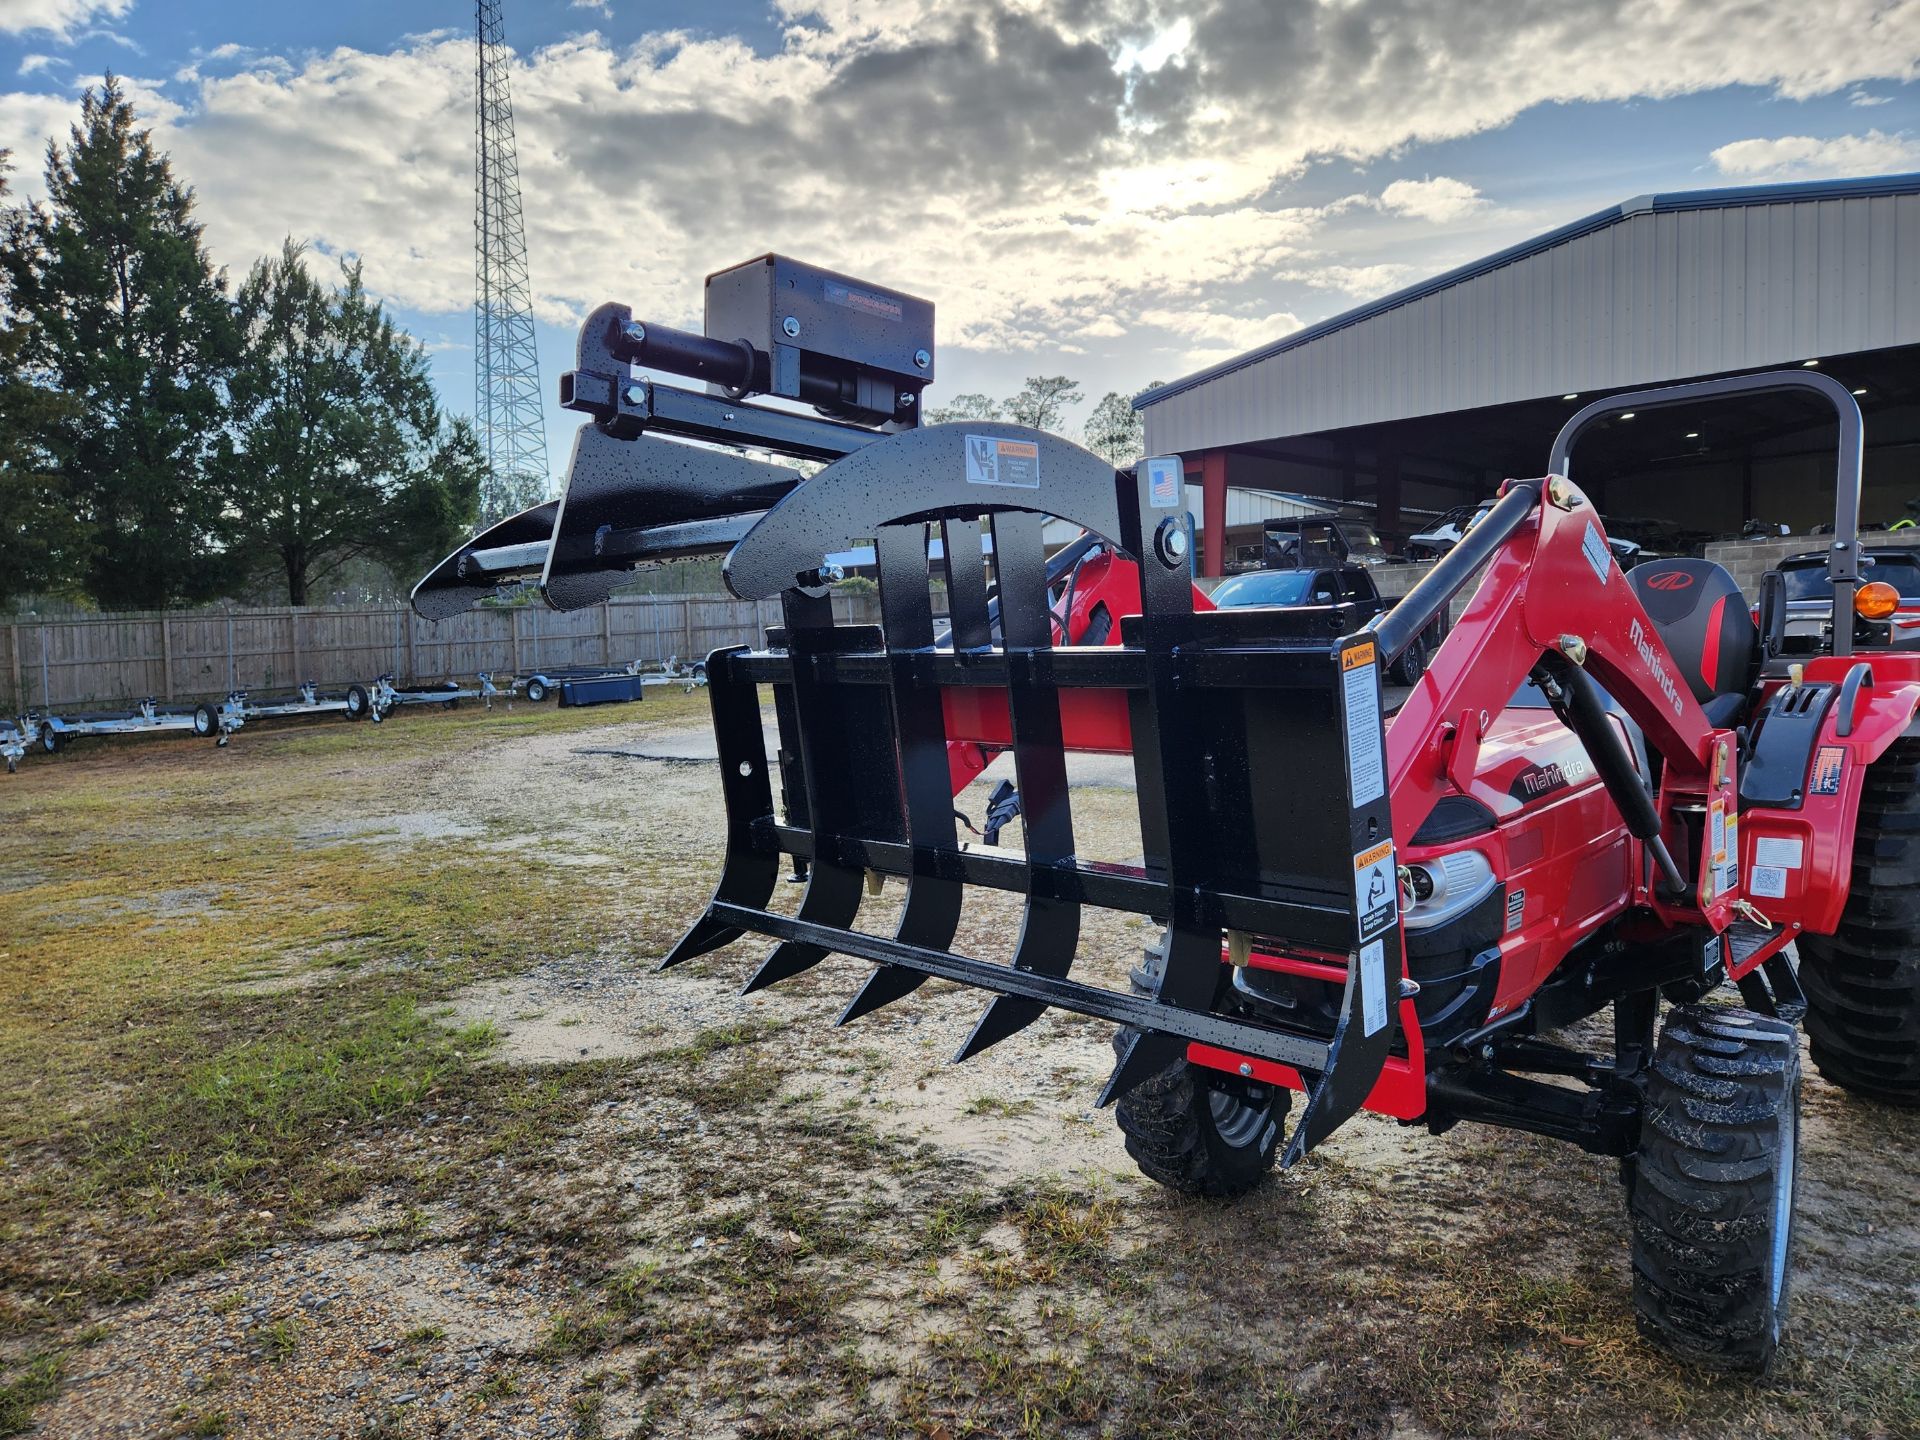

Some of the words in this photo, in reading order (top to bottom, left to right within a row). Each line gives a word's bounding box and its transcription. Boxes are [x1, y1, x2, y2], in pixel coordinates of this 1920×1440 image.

[1630, 617, 1683, 717] Mahindra
[1523, 761, 1584, 794] Mahindra
[1363, 845, 1390, 866] WARNING
